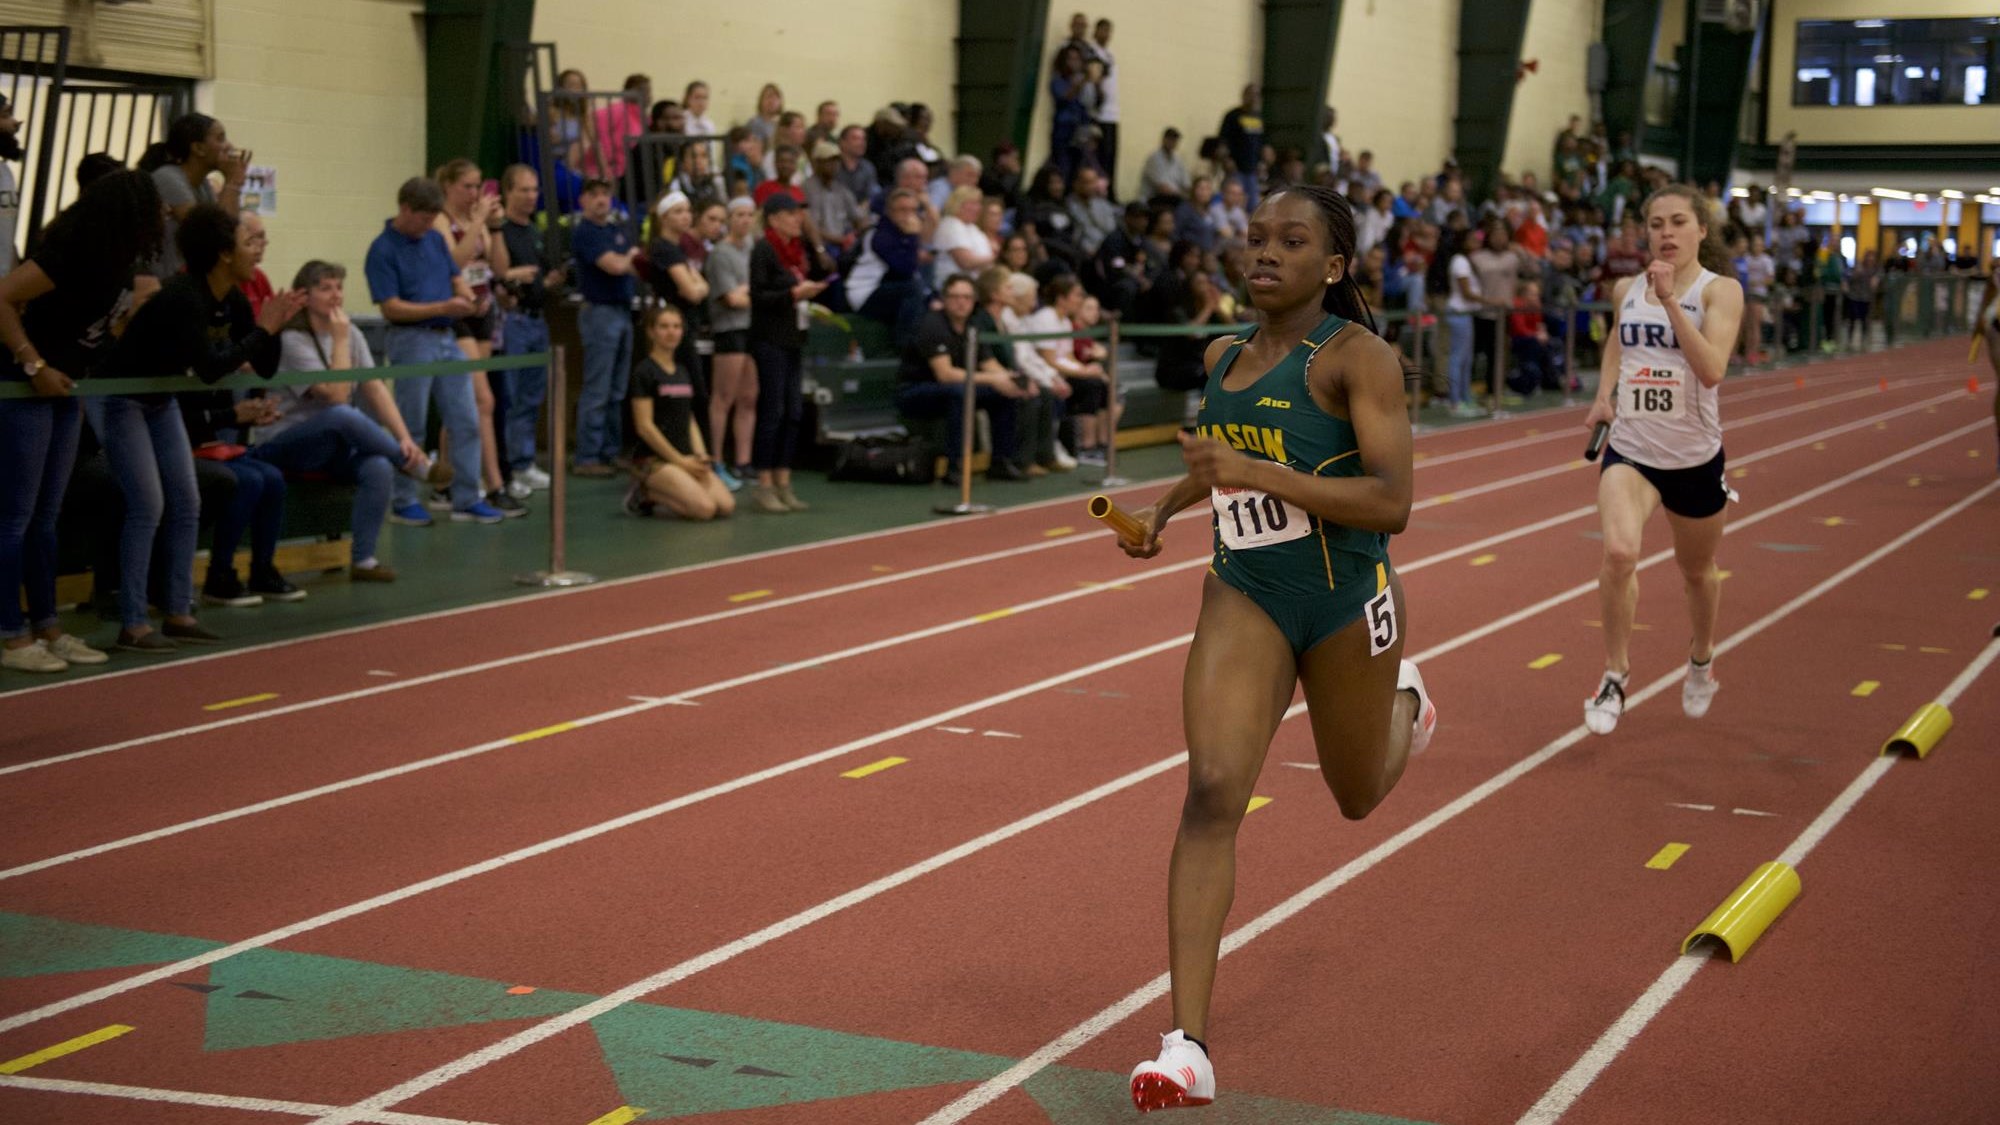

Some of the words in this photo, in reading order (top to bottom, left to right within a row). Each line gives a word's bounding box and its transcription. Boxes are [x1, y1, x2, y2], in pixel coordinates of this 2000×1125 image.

[1632, 388, 1673, 412] 163
[1228, 493, 1288, 537] 110
[1371, 593, 1393, 648] 5
